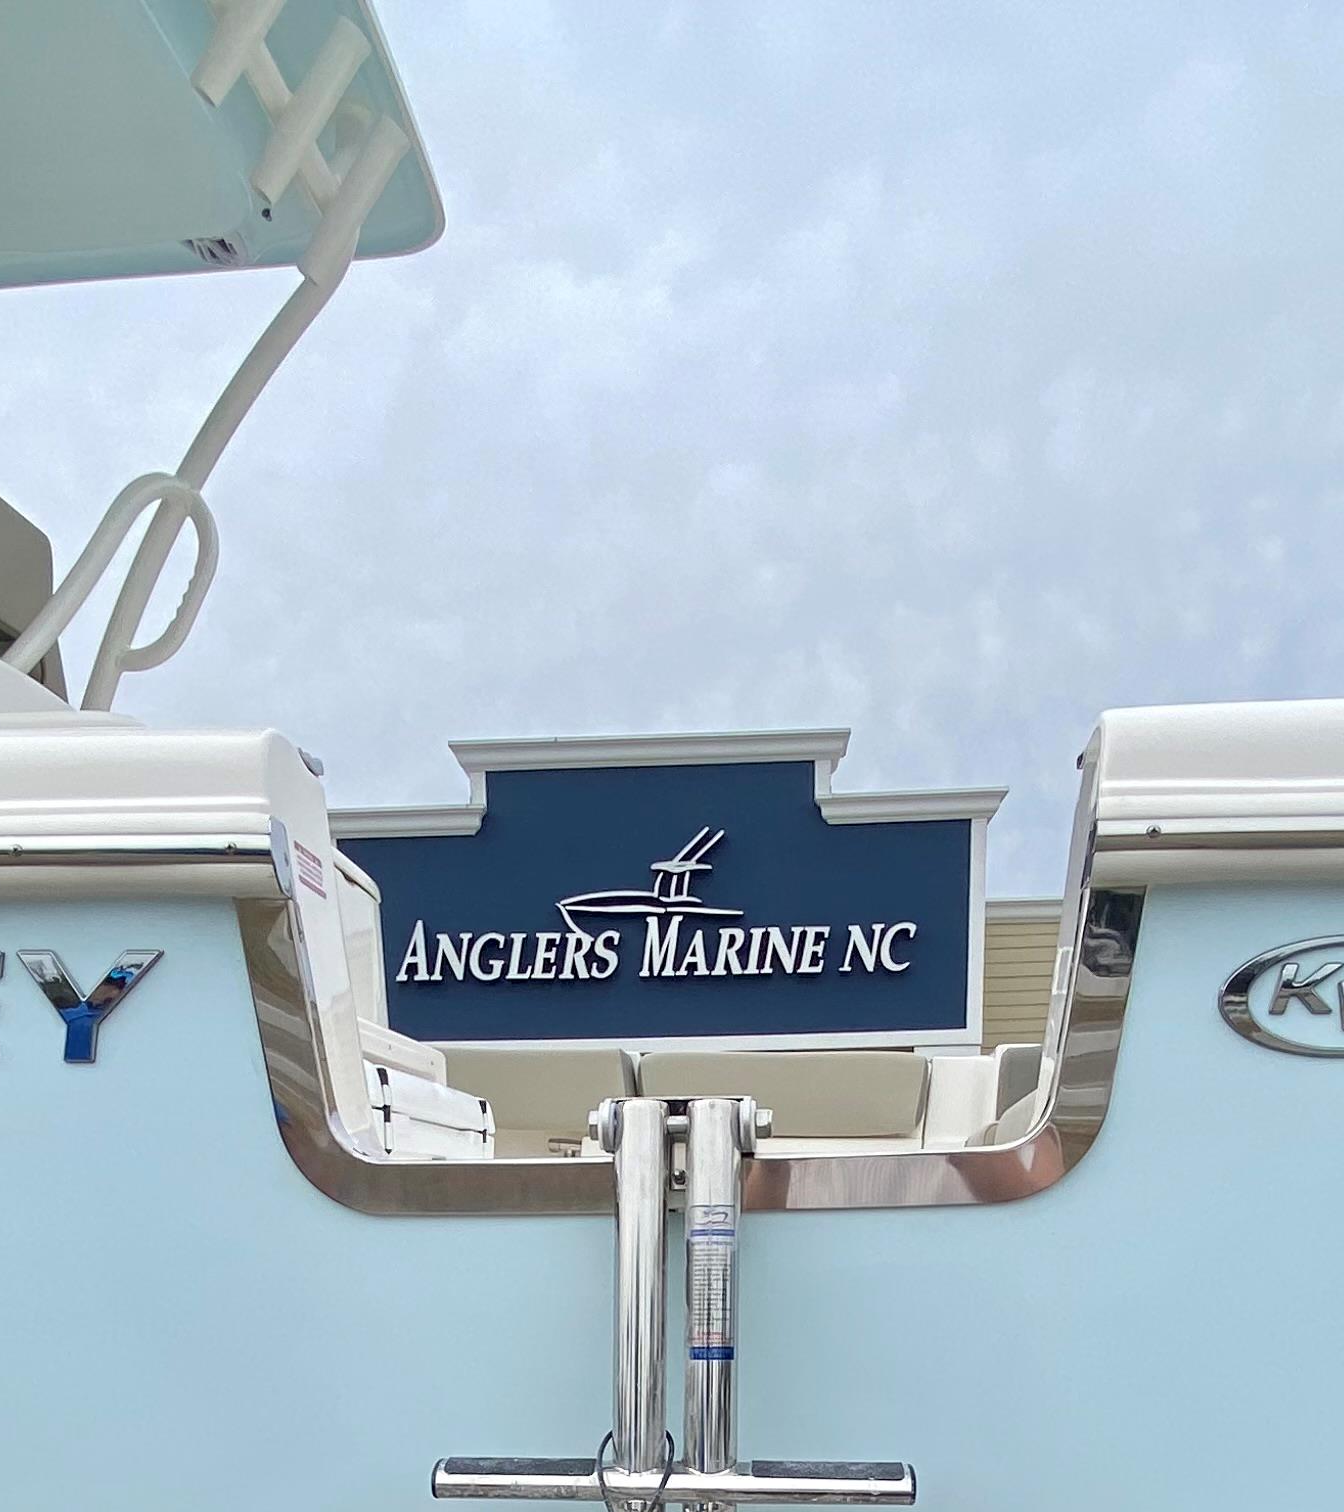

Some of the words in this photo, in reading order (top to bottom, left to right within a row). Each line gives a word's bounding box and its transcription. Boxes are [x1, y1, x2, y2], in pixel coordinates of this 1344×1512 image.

[395, 919, 619, 982] ANGLERS
[639, 914, 830, 977] MARINE
[838, 921, 916, 974] NC
